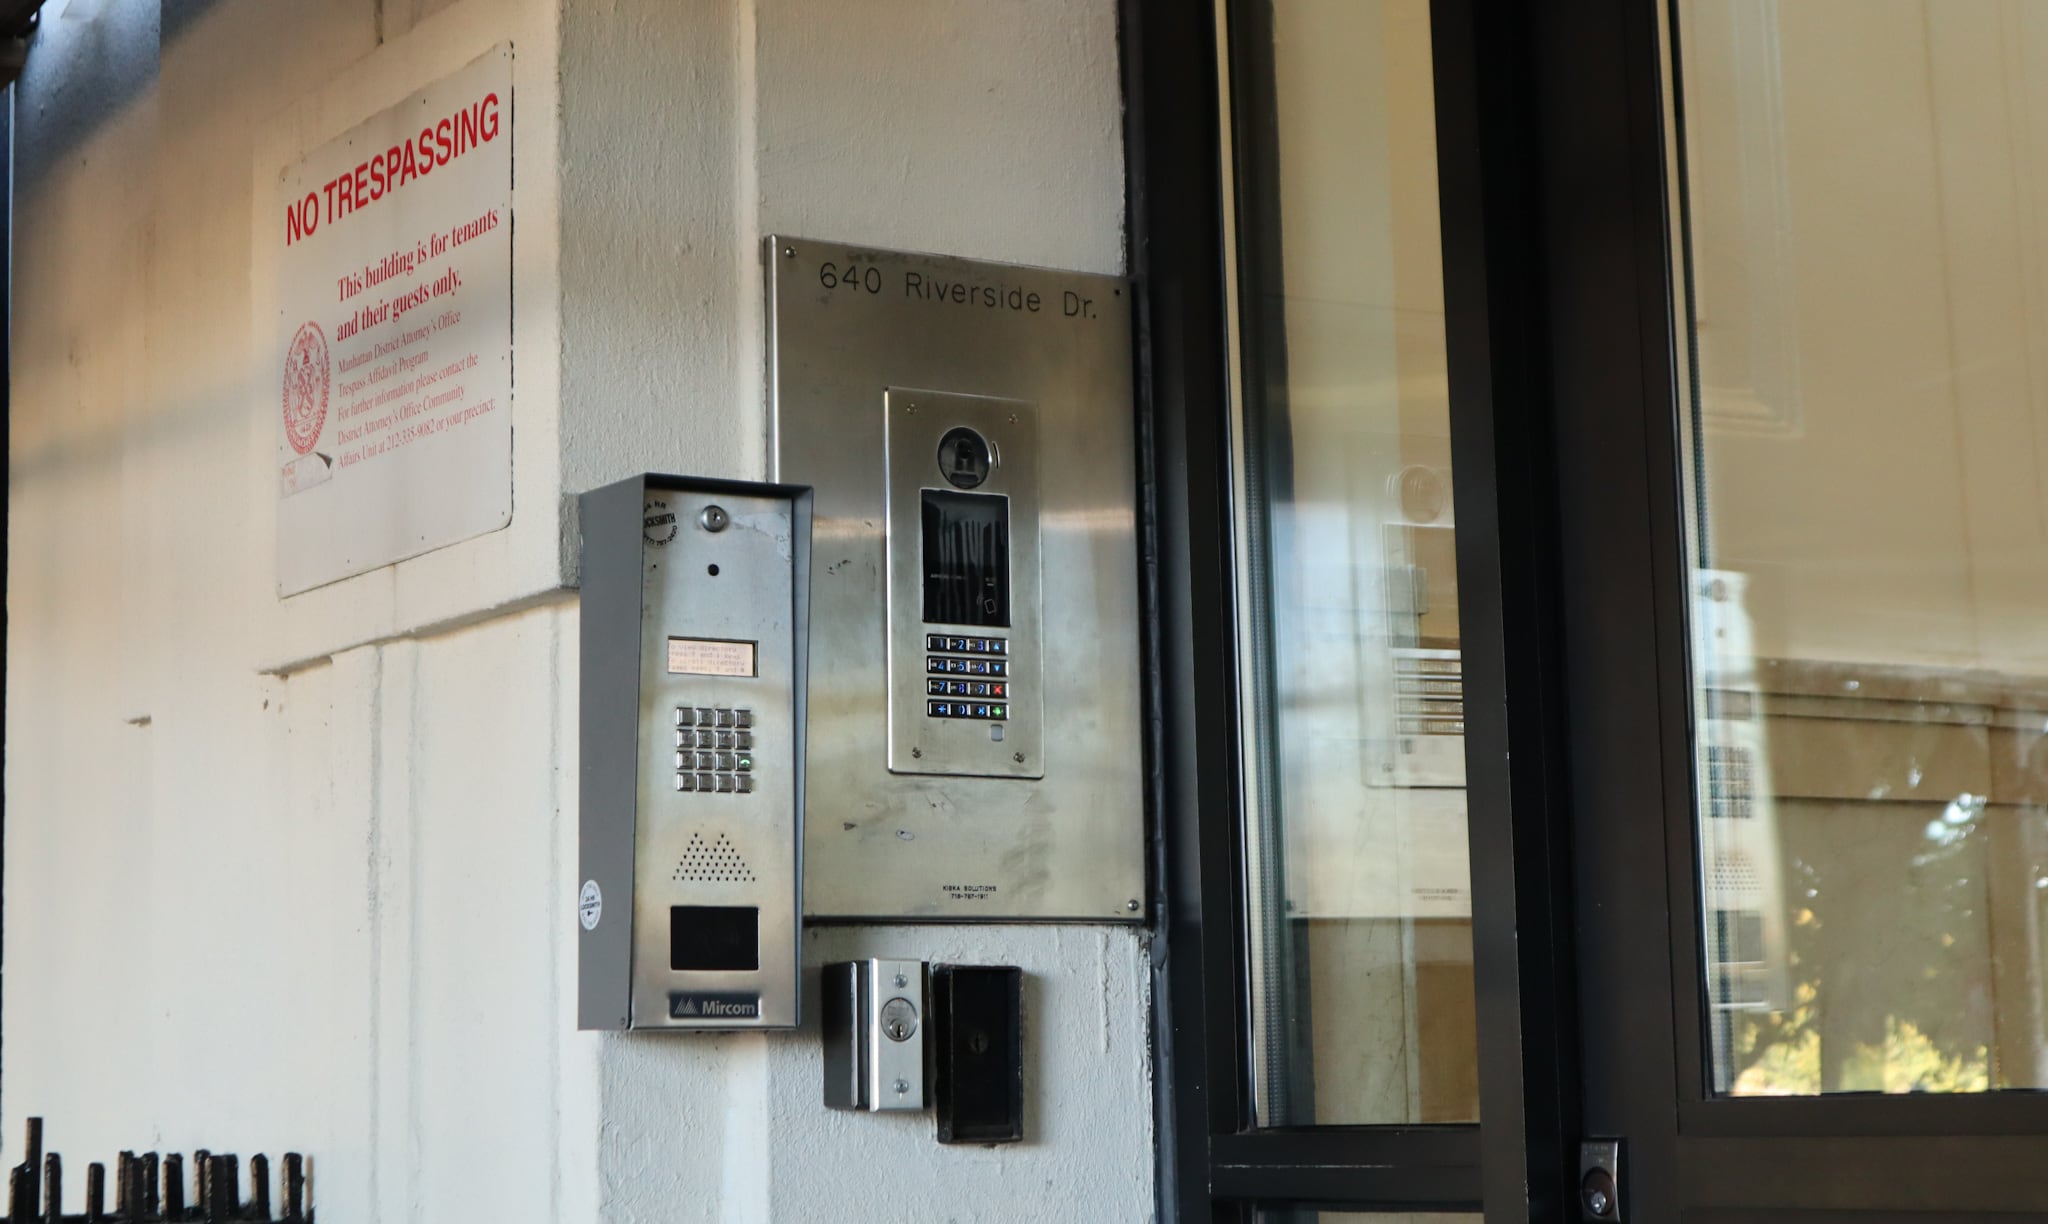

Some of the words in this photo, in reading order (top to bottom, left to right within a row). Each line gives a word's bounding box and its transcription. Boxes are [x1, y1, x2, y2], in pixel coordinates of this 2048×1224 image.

[286, 191, 319, 246] NO
[323, 92, 499, 225] TRESPASSING
[337, 271, 362, 302] This
[365, 251, 414, 289] building
[417, 240, 427, 265] is
[430, 232, 449, 259] for
[451, 208, 498, 248] tenants
[337, 311, 358, 342] and
[361, 299, 390, 331] their
[392, 282, 430, 324] guests
[432, 266, 462, 297] only.
[820, 262, 882, 294] 640
[905, 271, 1041, 313] Riverside
[1063, 290, 1097, 320] Dr.
[338, 350, 373, 375] Manhattan
[374, 338, 400, 360] District
[438, 310, 461, 331] Office
[338, 378, 366, 398] Trespass
[367, 362, 397, 386] Affidavit
[399, 350, 429, 372] Program
[338, 407, 349, 422] For
[351, 394, 373, 417] further
[374, 383, 414, 406] information
[415, 371, 438, 394] please
[438, 358, 465, 381] contact
[466, 352, 478, 370] the
[338, 426, 362, 445] District
[399, 399, 422, 421] Office
[423, 383, 465, 411] Community
[338, 449, 361, 470] Affairs
[362, 442, 377, 460] Unit
[378, 441, 386, 454] at
[436, 419, 445, 430] or
[445, 410, 462, 432] your
[702, 1000, 755, 1015] Mircom
